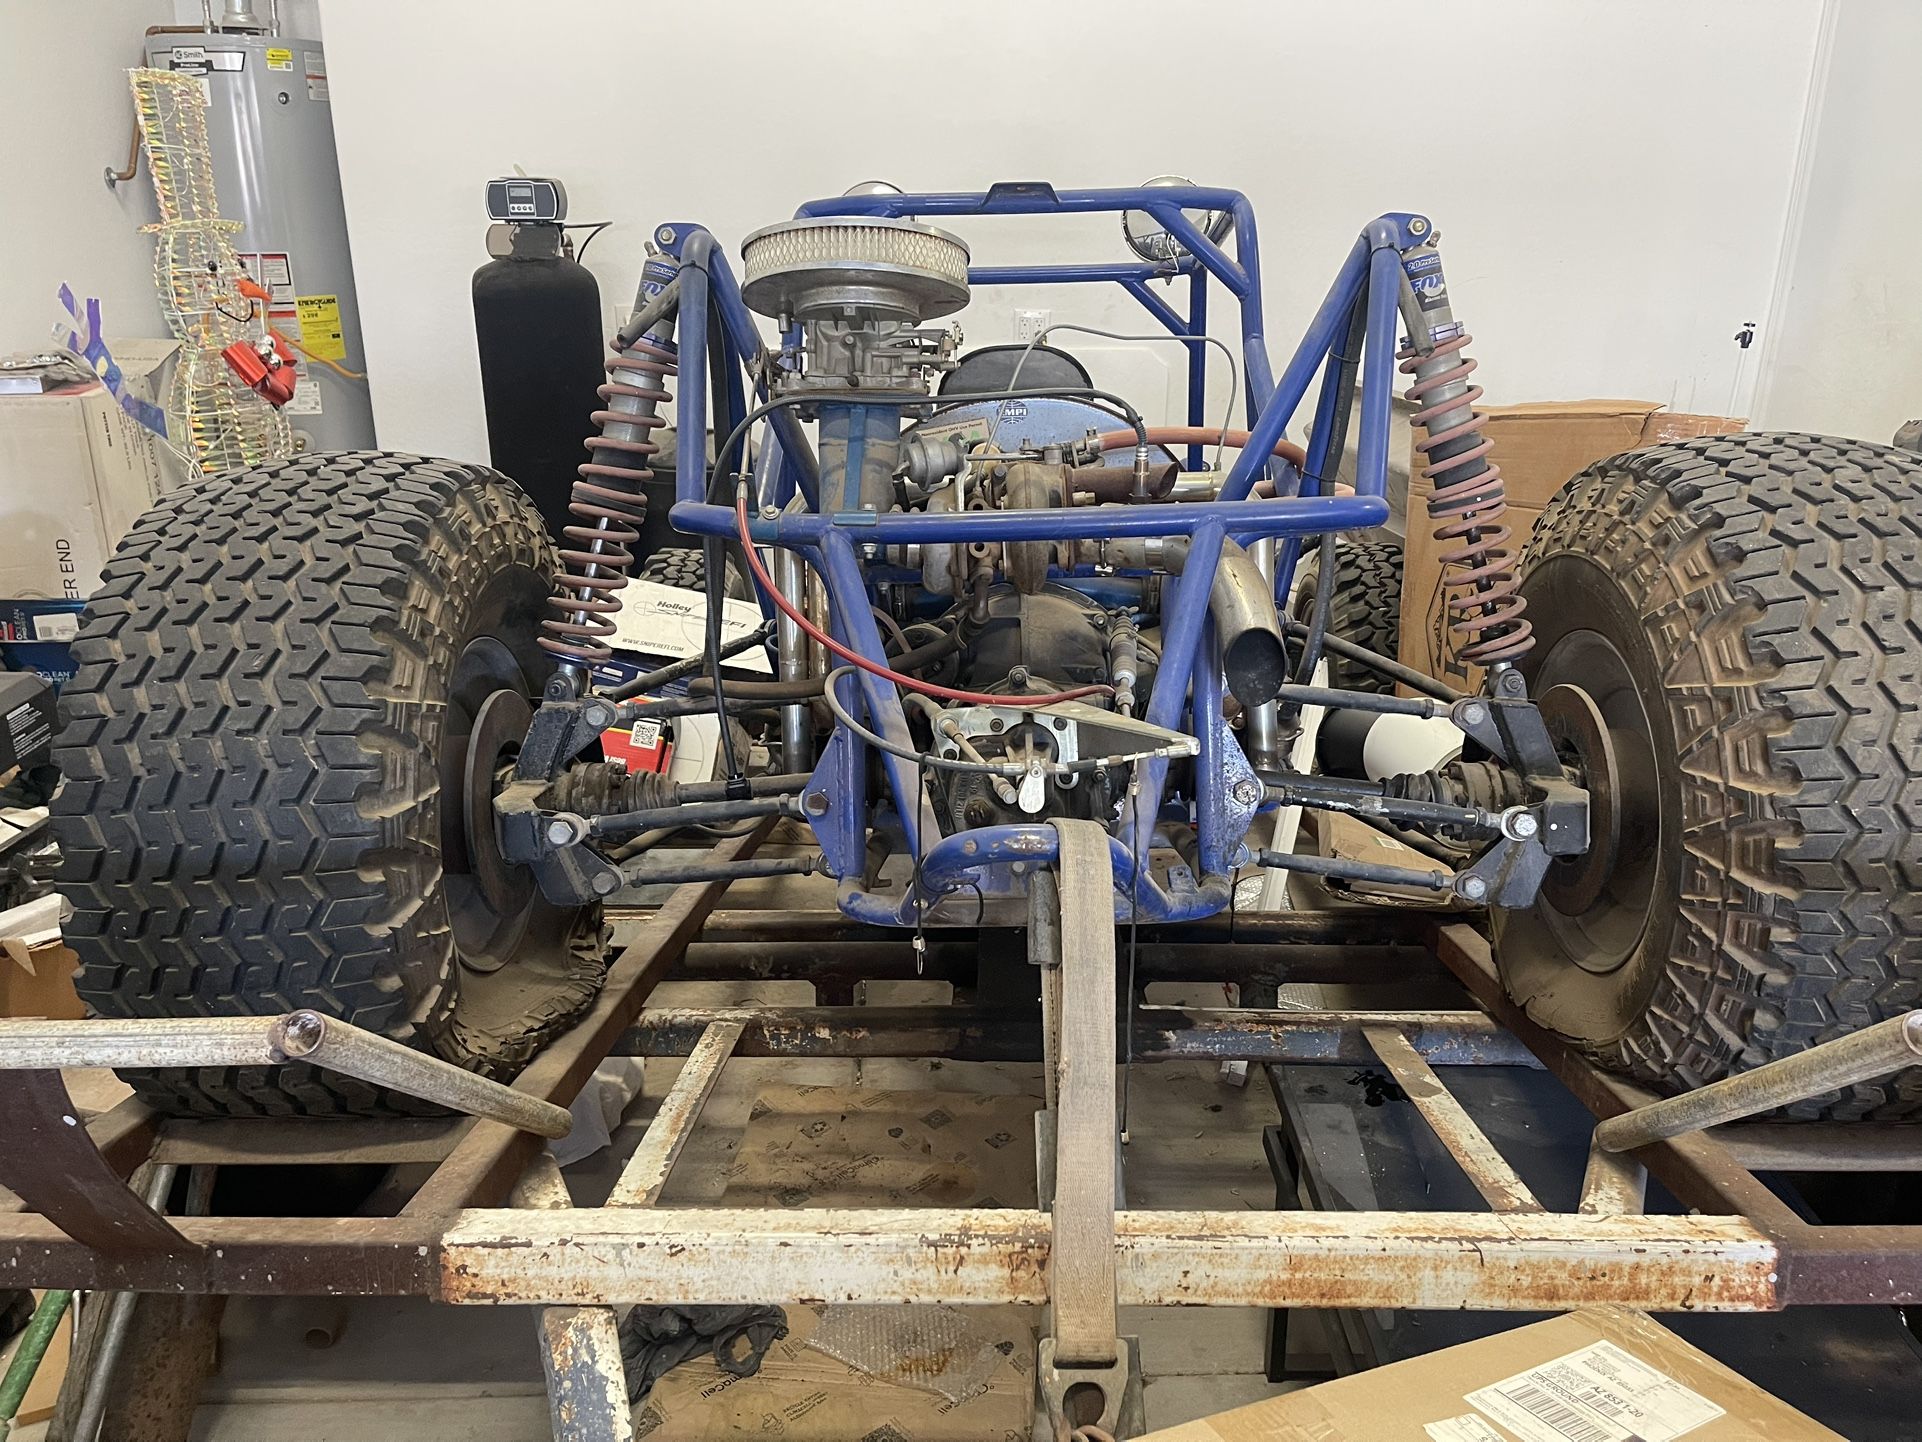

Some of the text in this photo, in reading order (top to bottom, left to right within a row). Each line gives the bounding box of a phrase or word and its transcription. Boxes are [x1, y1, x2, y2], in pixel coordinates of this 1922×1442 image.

[183, 51, 204, 59] Smith
[1411, 272, 1444, 294] FOX
[1000, 408, 1027, 416] MPI
[56, 539, 74, 573] END
[656, 601, 692, 613] Holley
[622, 637, 685, 653] WWW.SNIPEREFI.COM
[1531, 1372, 1580, 1405] UPS GROUND
[1590, 1385, 1645, 1419] AZ 853 1-20
